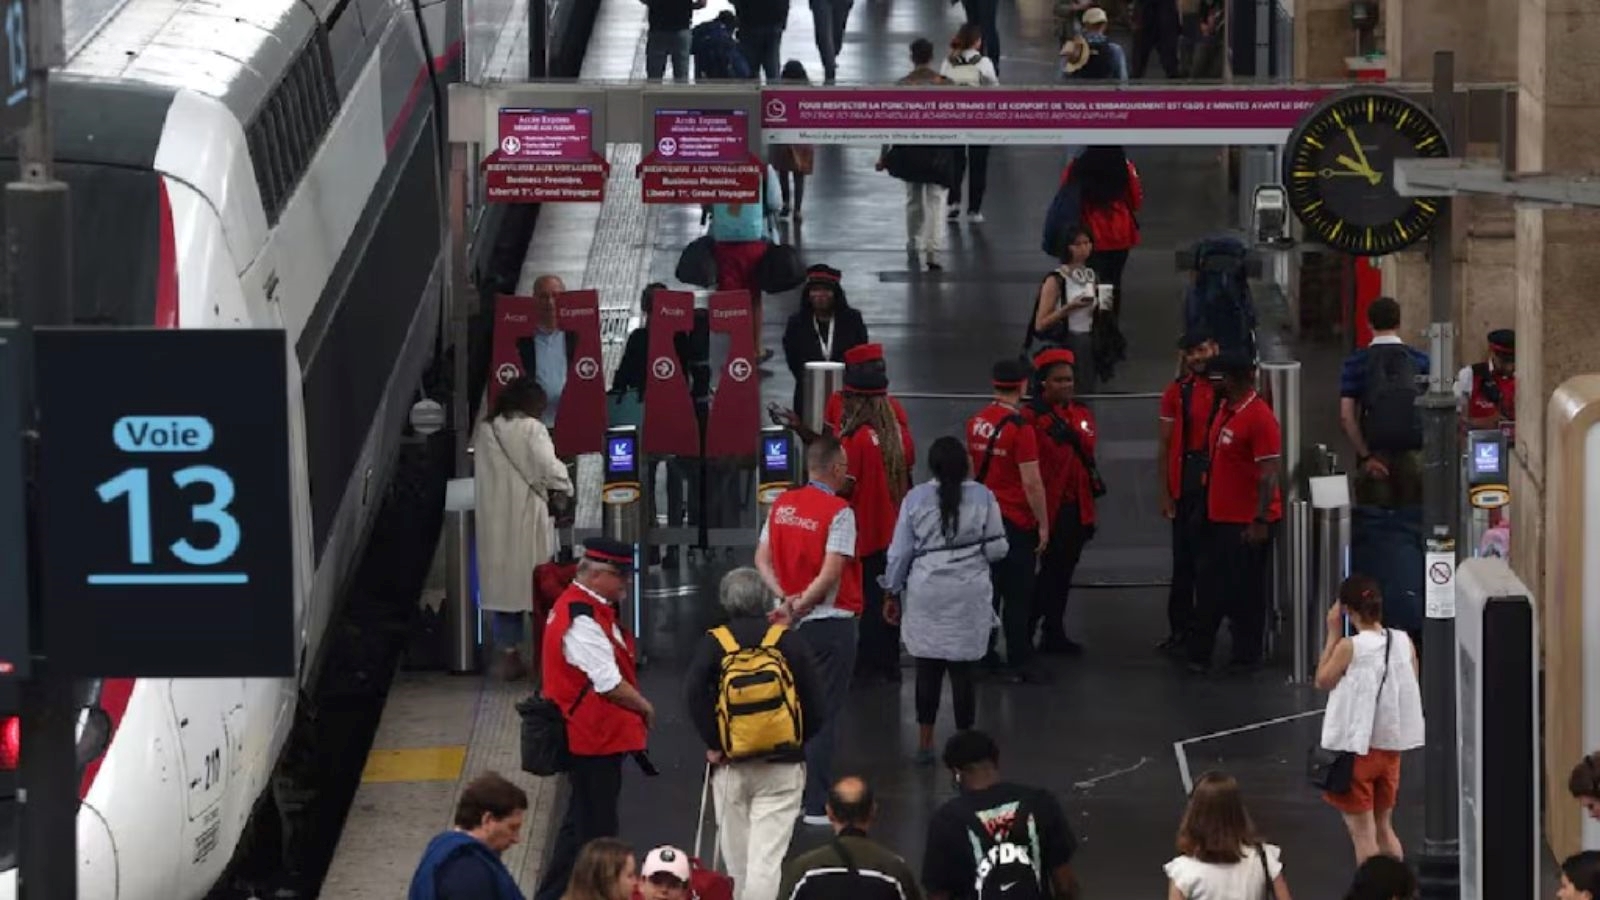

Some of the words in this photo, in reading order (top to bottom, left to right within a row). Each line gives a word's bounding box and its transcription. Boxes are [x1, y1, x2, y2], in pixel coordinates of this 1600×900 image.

[823, 102, 867, 110] RESPECTER
[869, 102, 880, 110] LA
[987, 102, 997, 110] ET
[999, 102, 1008, 110] LE
[1010, 102, 1049, 110] CONFORT
[1051, 102, 1062, 110] DE
[1213, 102, 1250, 110] MINUTES
[1252, 102, 1280, 110] AVANT
[1281, 102, 1293, 110] LE
[506, 176, 541, 184] Business
[662, 178, 699, 186] Business
[534, 188, 561, 197] Grand
[562, 188, 600, 197] Voyageur
[692, 189, 716, 198] Grand
[718, 189, 755, 198] Voyageur
[559, 307, 594, 318] Express
[660, 306, 685, 317] Accès
[713, 307, 748, 319] Express
[126, 421, 200, 446] Voie
[96, 464, 241, 566] 13
